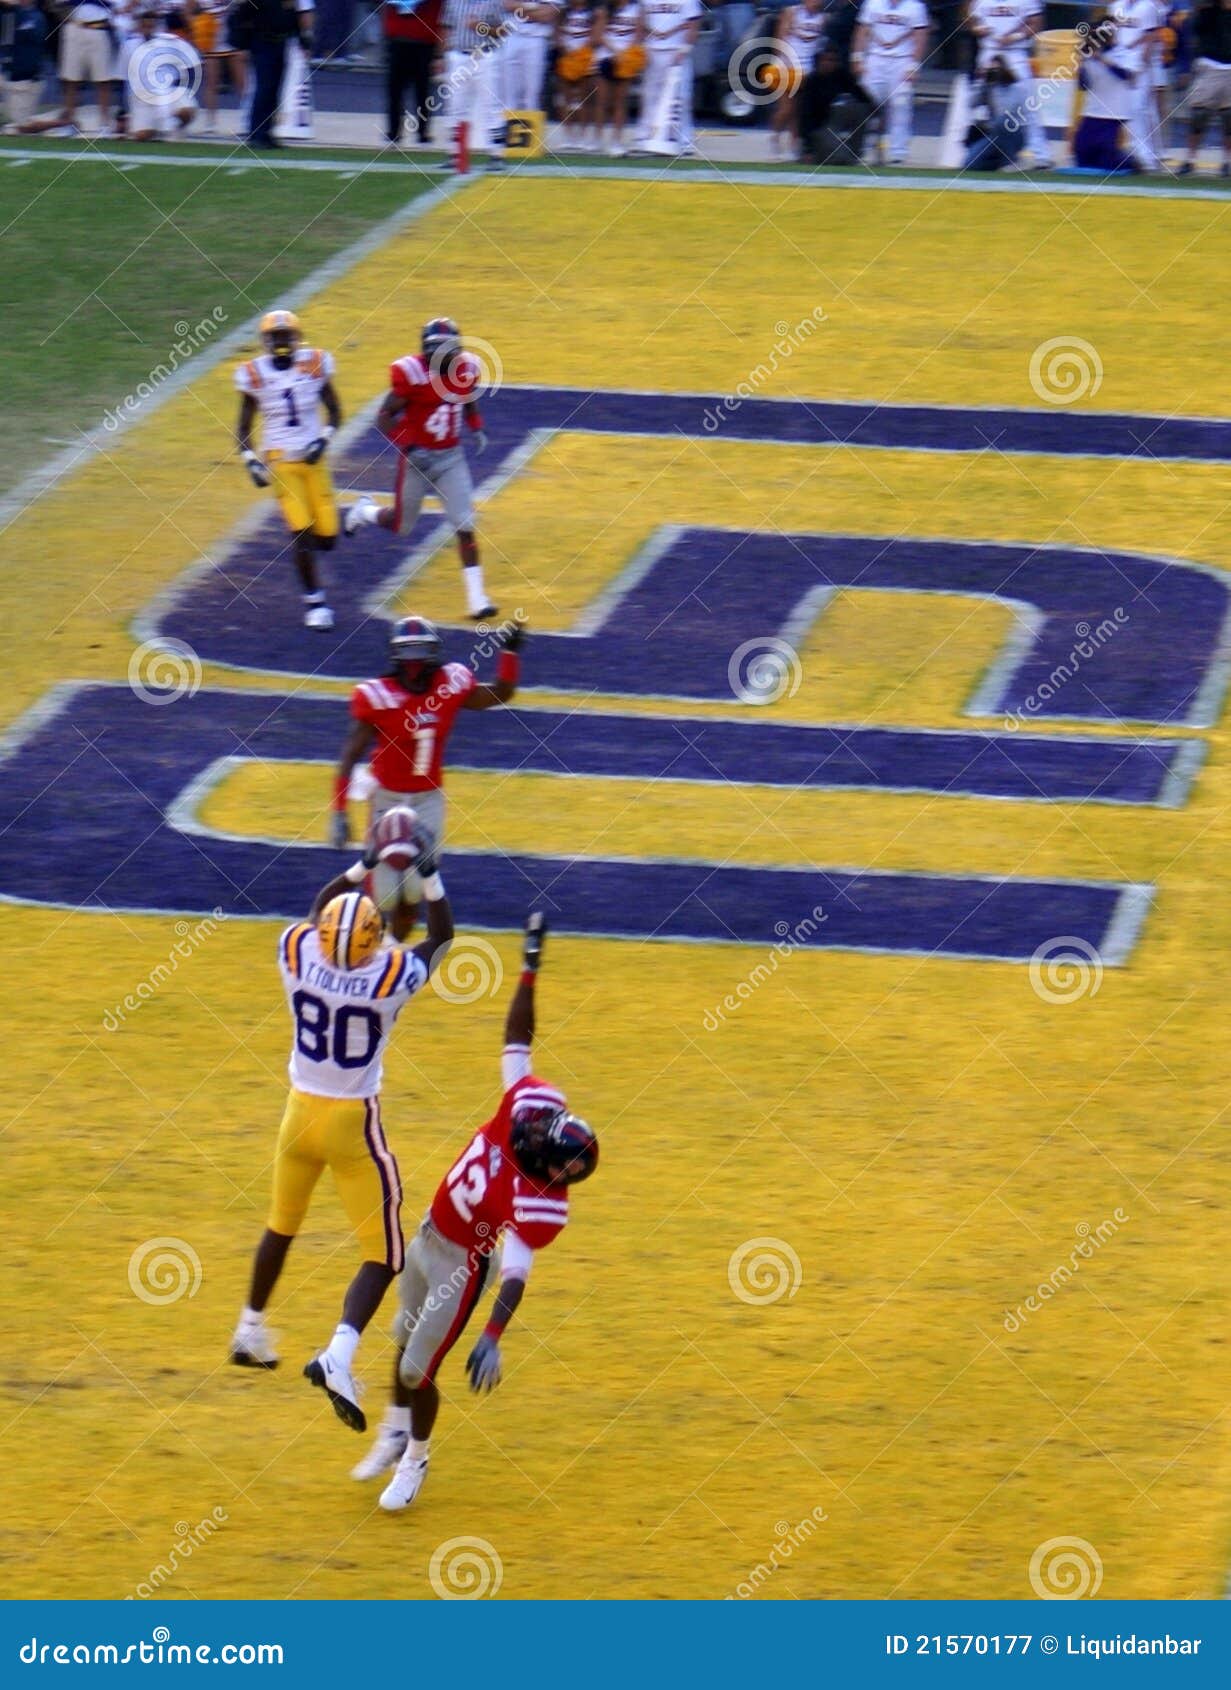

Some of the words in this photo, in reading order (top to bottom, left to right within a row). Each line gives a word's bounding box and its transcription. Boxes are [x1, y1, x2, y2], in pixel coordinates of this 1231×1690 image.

[282, 387, 300, 427] 1
[424, 402, 463, 441] 41
[413, 728, 437, 777] 1
[292, 989, 382, 1069] 80
[447, 1133, 487, 1224] 12
